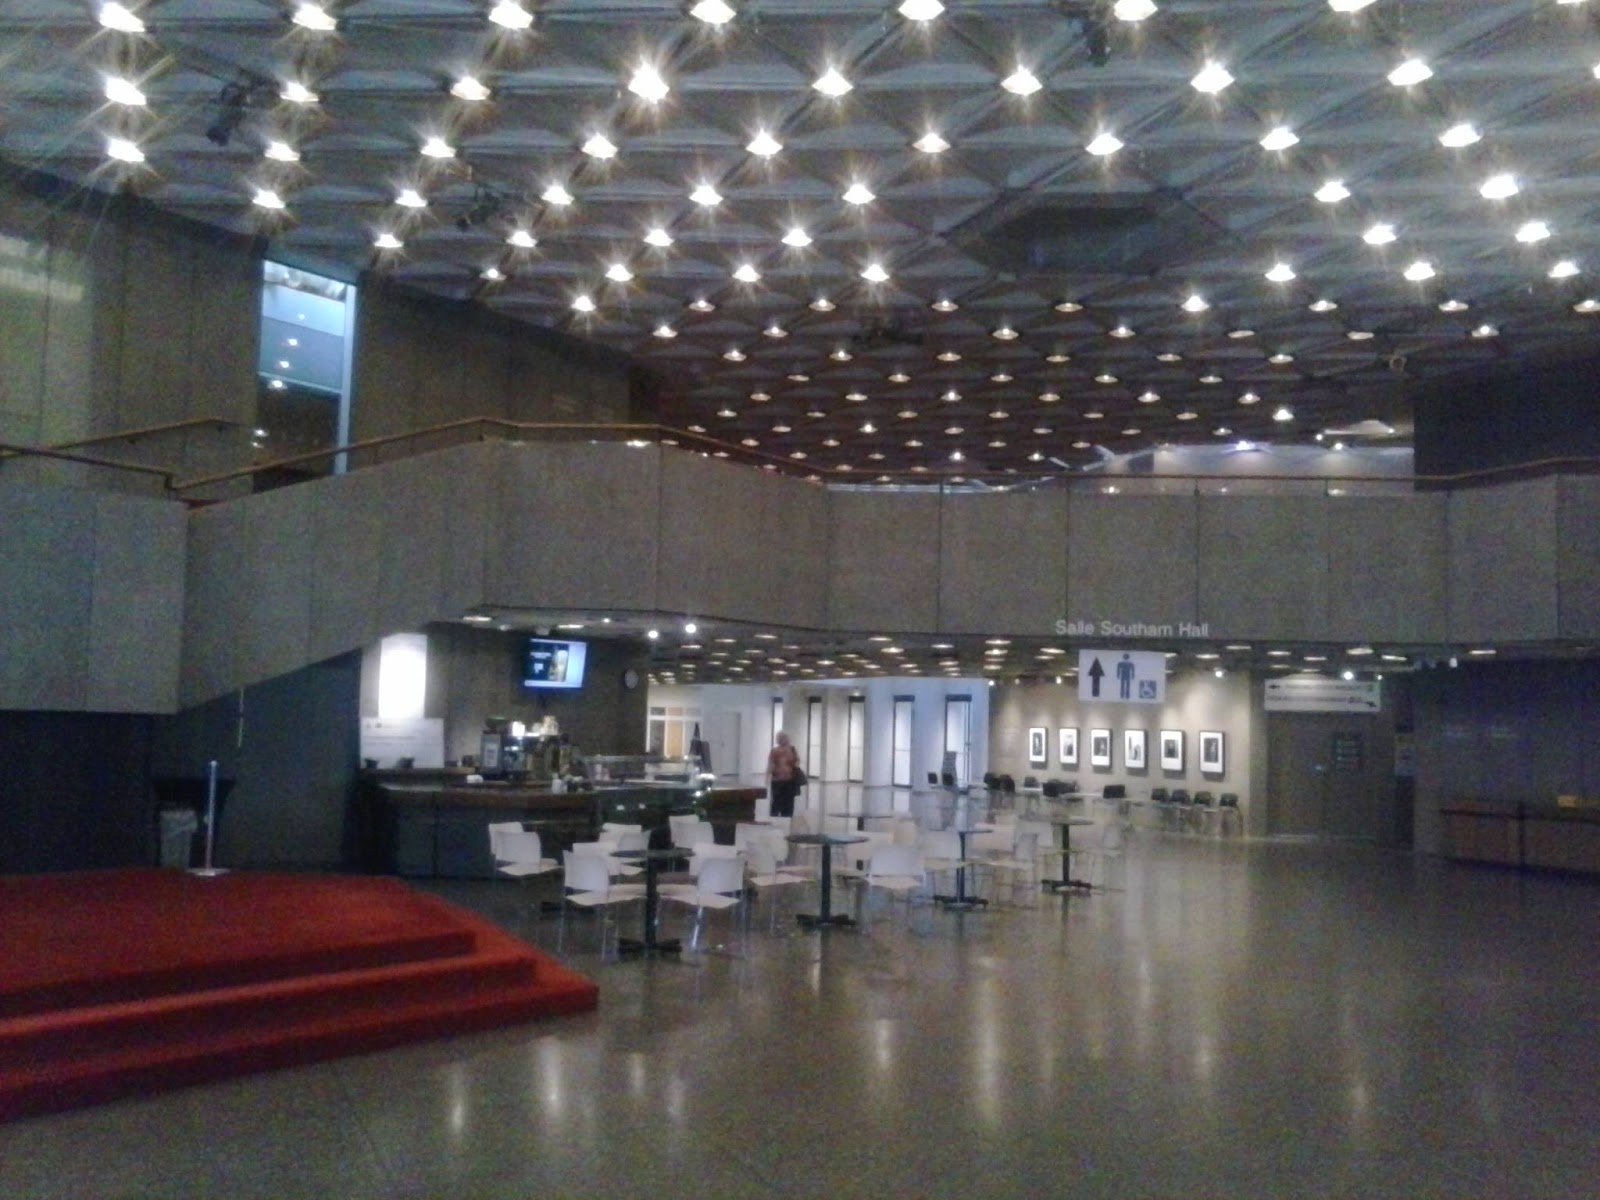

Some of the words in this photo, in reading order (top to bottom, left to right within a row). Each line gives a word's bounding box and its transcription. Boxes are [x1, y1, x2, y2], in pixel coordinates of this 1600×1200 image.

[1055, 618, 1095, 636] Salle
[1100, 619, 1173, 637] Southam
[1178, 622, 1209, 638] Hall
